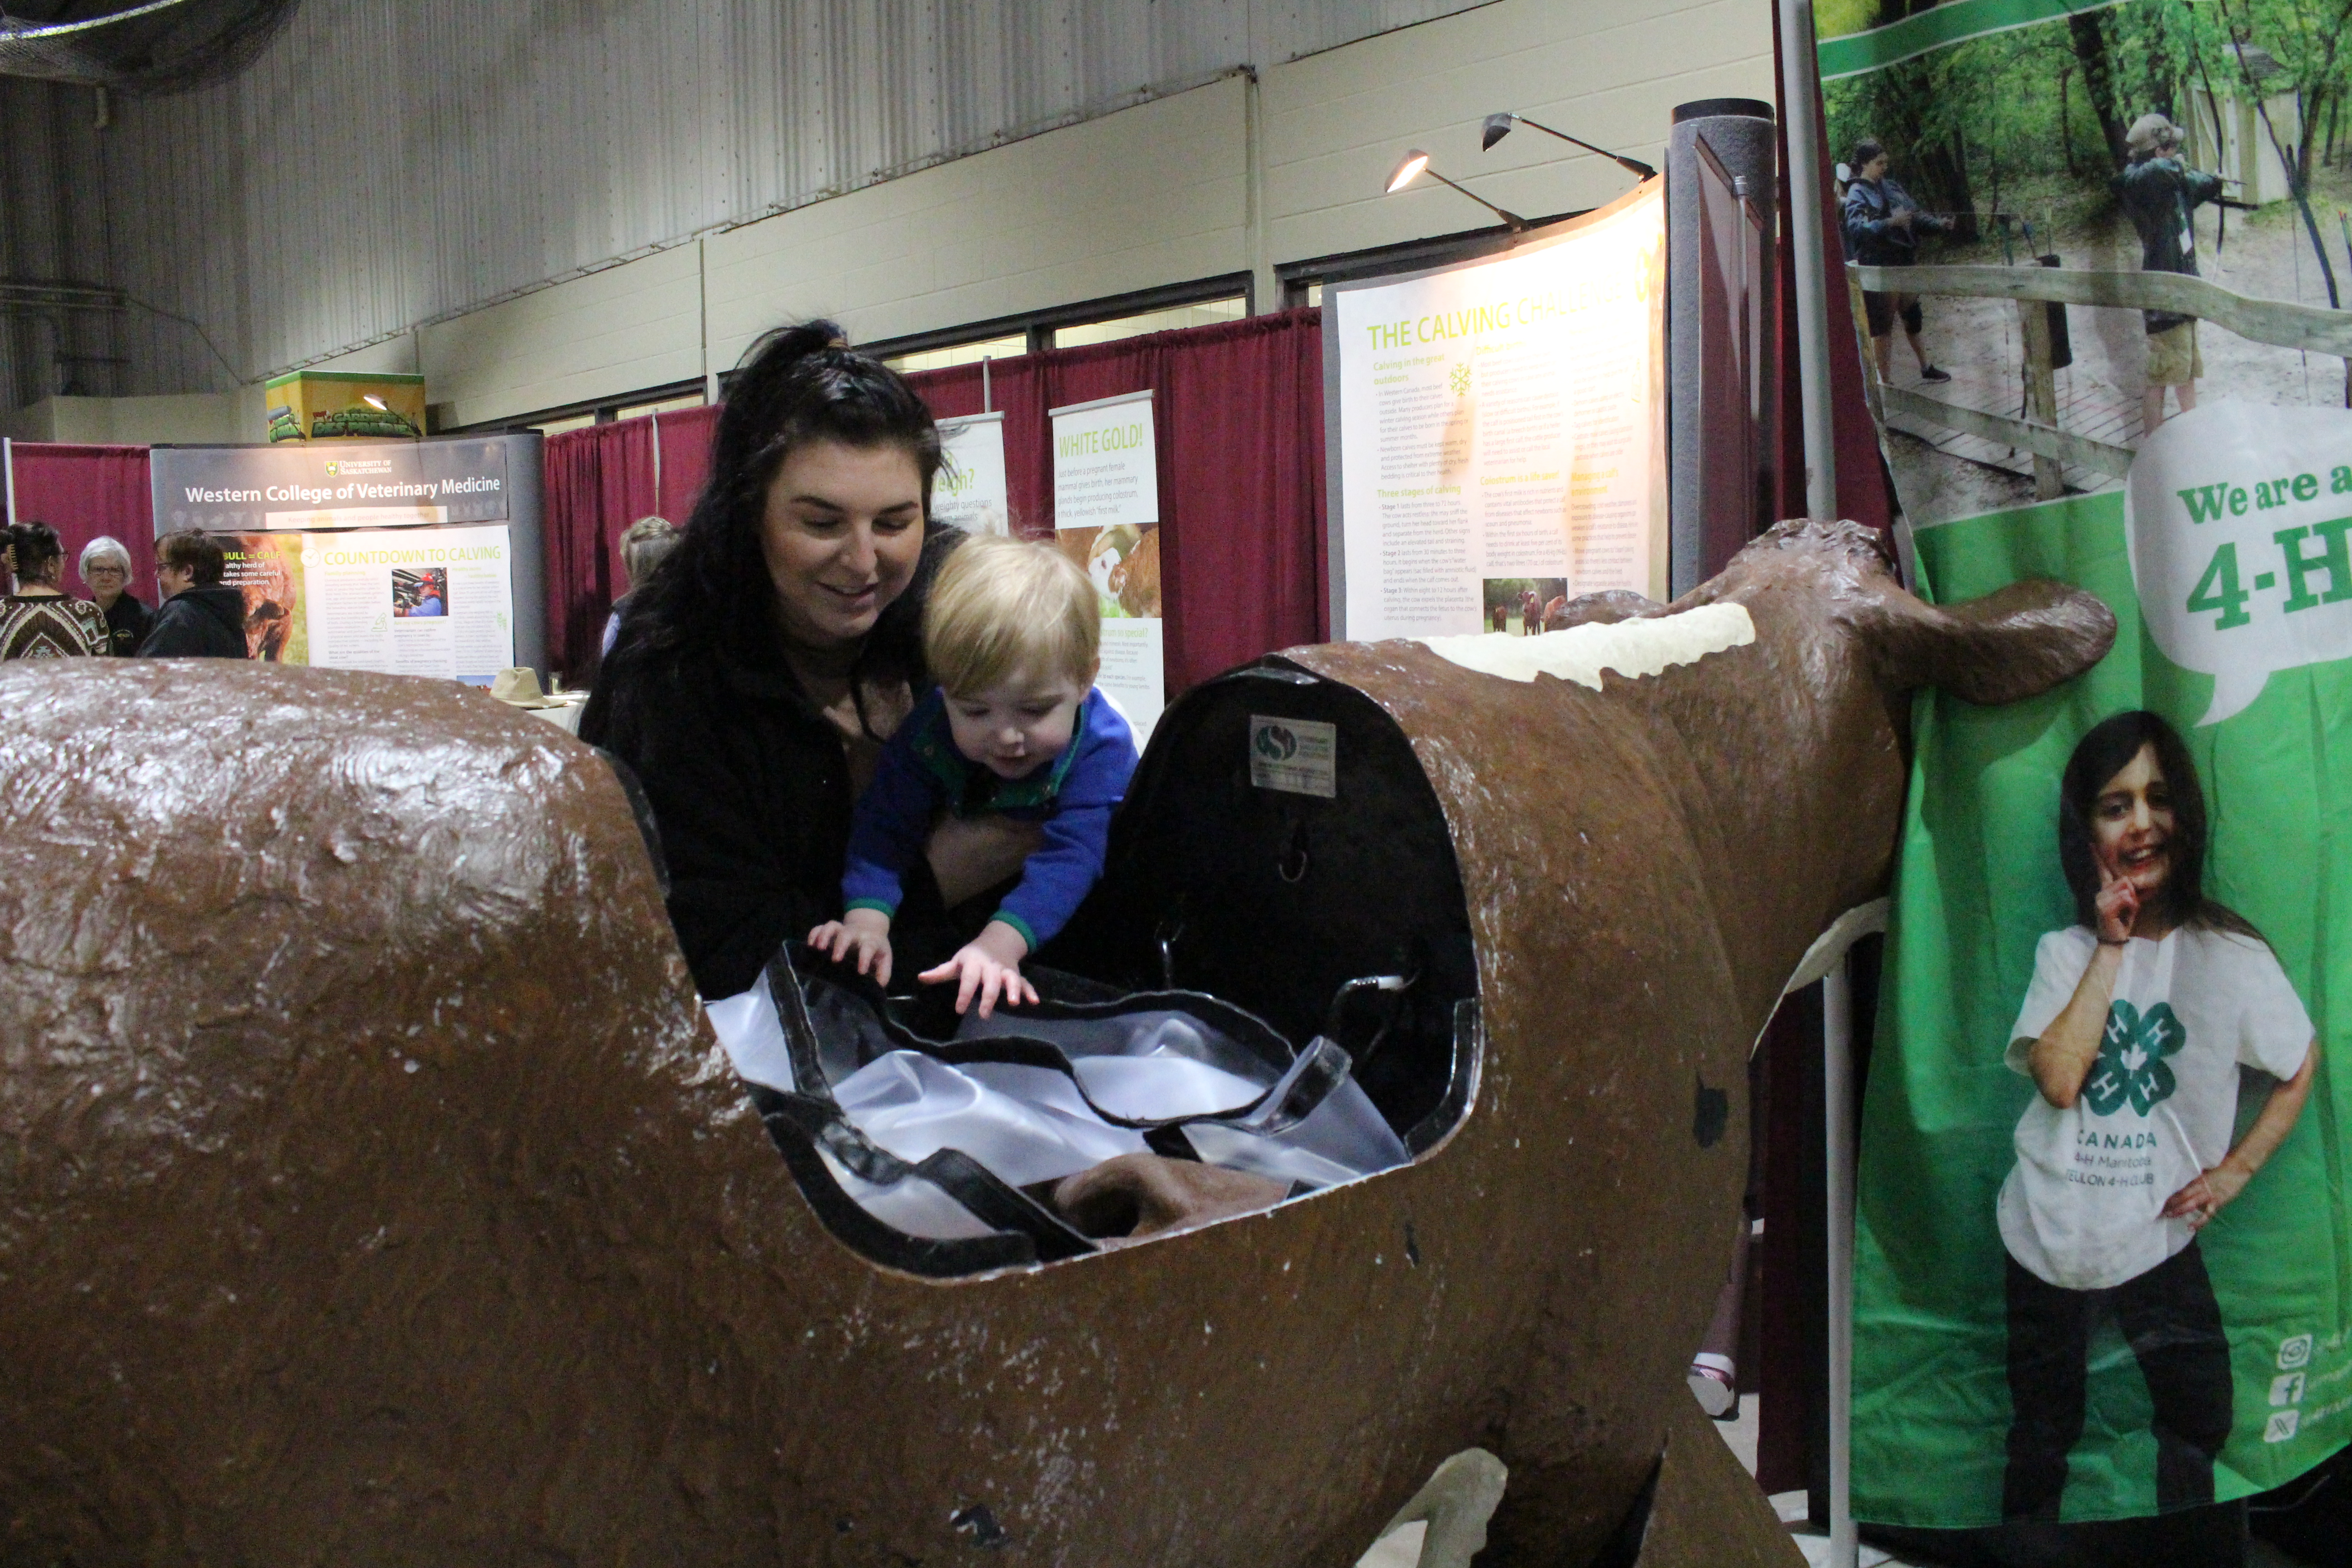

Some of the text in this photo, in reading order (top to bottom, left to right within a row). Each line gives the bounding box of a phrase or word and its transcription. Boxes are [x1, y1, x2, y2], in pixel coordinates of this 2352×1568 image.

[1367, 320, 1411, 350] THE
[1417, 302, 1510, 342] CALVING
[1517, 273, 1622, 324] CHALLENGE
[1374, 354, 1445, 371] Calving in the great
[1374, 375, 1408, 385] outdoors
[1403, 386, 1420, 394] Canada,
[1398, 406, 1410, 415] Many
[1411, 403, 1432, 413] producers
[1433, 402, 1443, 410] plan
[1395, 415, 1411, 424] calving
[1454, 409, 1464, 417] plan
[1449, 418, 1462, 427] spring
[1059, 423, 1143, 458] WHITE GOLD!
[1058, 470, 1067, 478] Just
[1068, 467, 1082, 476] before
[1087, 465, 1108, 476] pregnant
[1109, 461, 1125, 471] female
[1572, 470, 1600, 484] Managing
[1058, 482, 1077, 491] mammal
[1078, 481, 1090, 491] gives
[1091, 480, 1103, 488] birth,
[1114, 476, 1138, 485] mammary
[1480, 473, 1515, 485] Colostrum
[1518, 473, 1523, 482] is
[1530, 470, 1539, 481] life
[185, 476, 500, 504] Western College of Veterinary Medicine
[1377, 483, 1460, 498] Three stages of calving
[1572, 484, 1608, 497] environment
[934, 499, 992, 512] weighty questions
[1058, 490, 1138, 506] glands begin producing colostrum,
[2177, 482, 2248, 525] We
[2256, 471, 2318, 511] are
[404, 512, 429, 520] together
[953, 511, 978, 521] animals
[1061, 509, 1073, 518] thick,
[1074, 507, 1096, 519] yellowish
[223, 552, 247, 560] BULL
[324, 546, 500, 565] COUNTDOWN TO CALVING
[2186, 516, 2352, 632] 4-H
[1125, 628, 1148, 639] special?
[2107, 1014, 2172, 1045] H H
[2091, 1071, 2160, 1102] H H
[2077, 1129, 2157, 1149] CANADA
[2074, 1152, 2151, 1168] 4-H Manitoba
